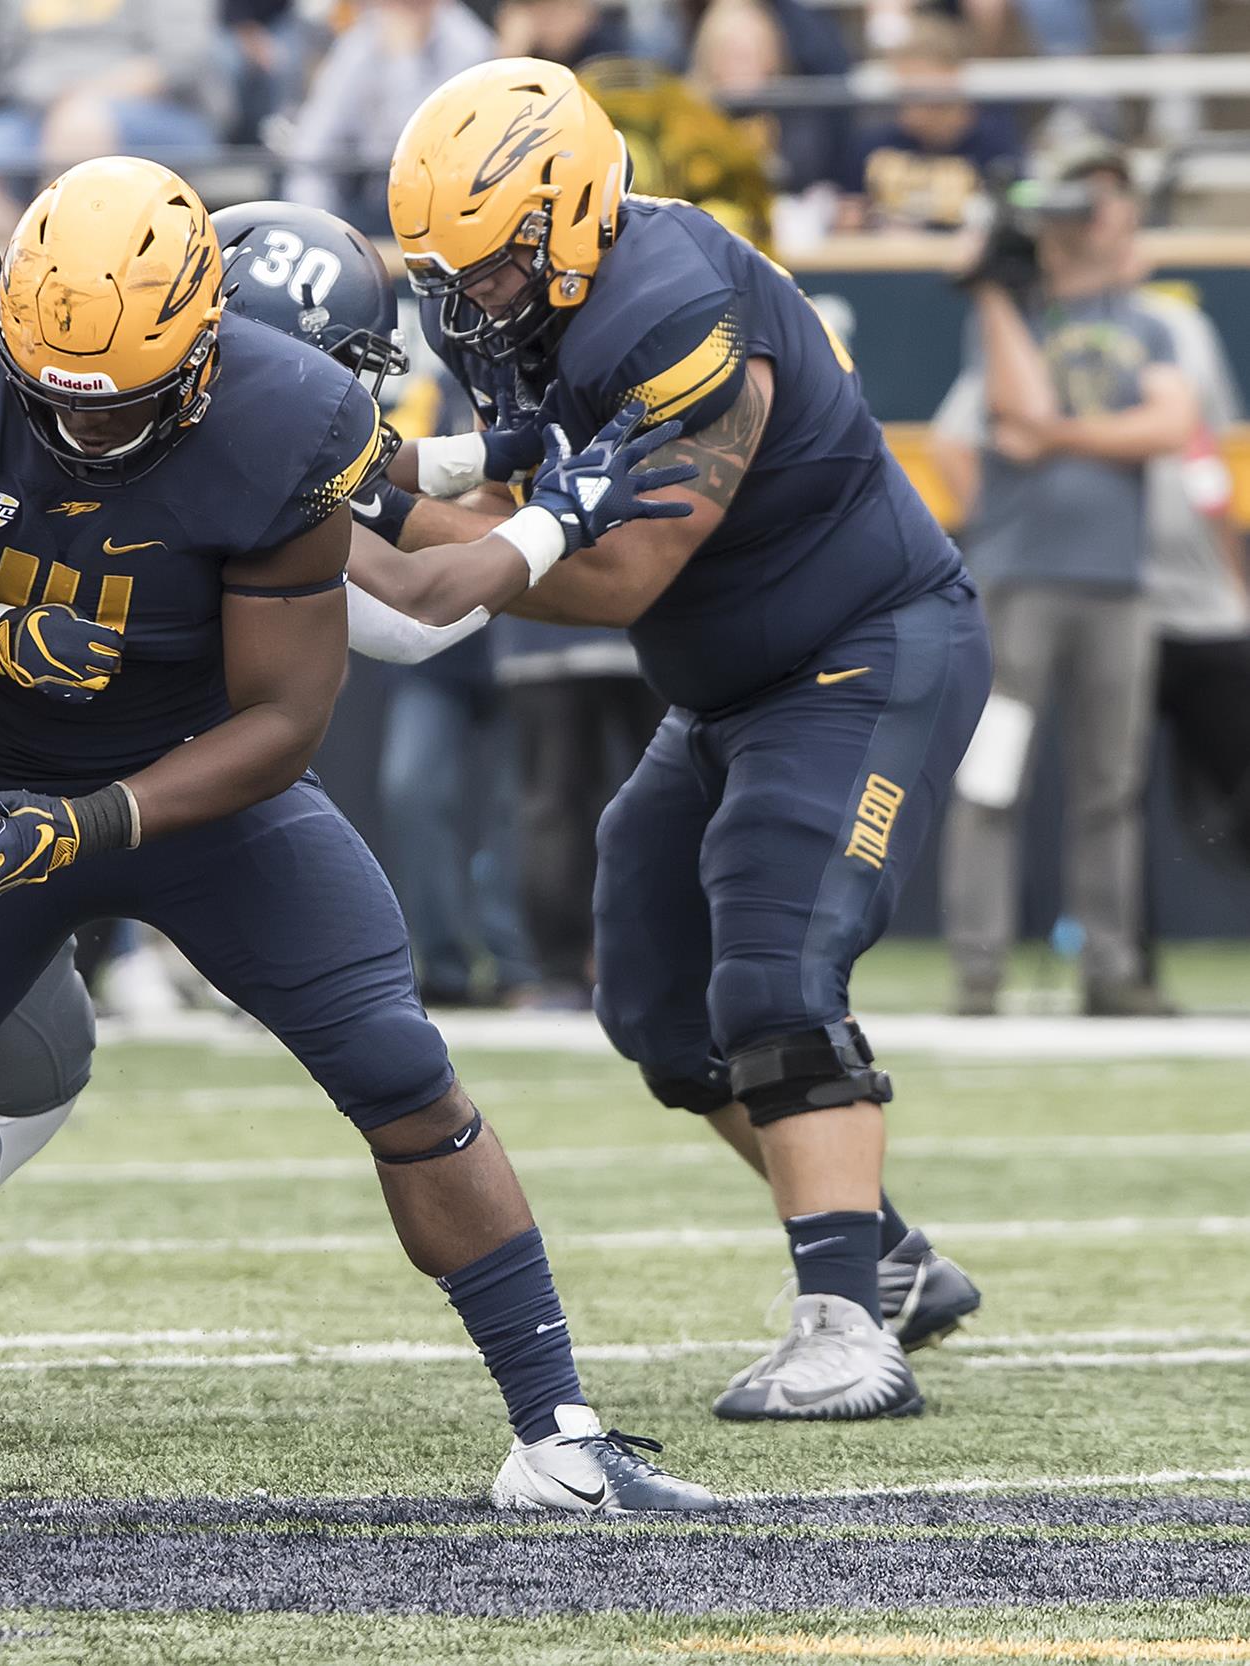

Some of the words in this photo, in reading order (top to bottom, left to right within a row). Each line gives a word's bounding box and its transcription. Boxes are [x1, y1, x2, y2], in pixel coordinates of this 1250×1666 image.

[249, 229, 342, 306] 30
[48, 372, 103, 391] Riddell
[844, 773, 905, 870] TOLEDO
